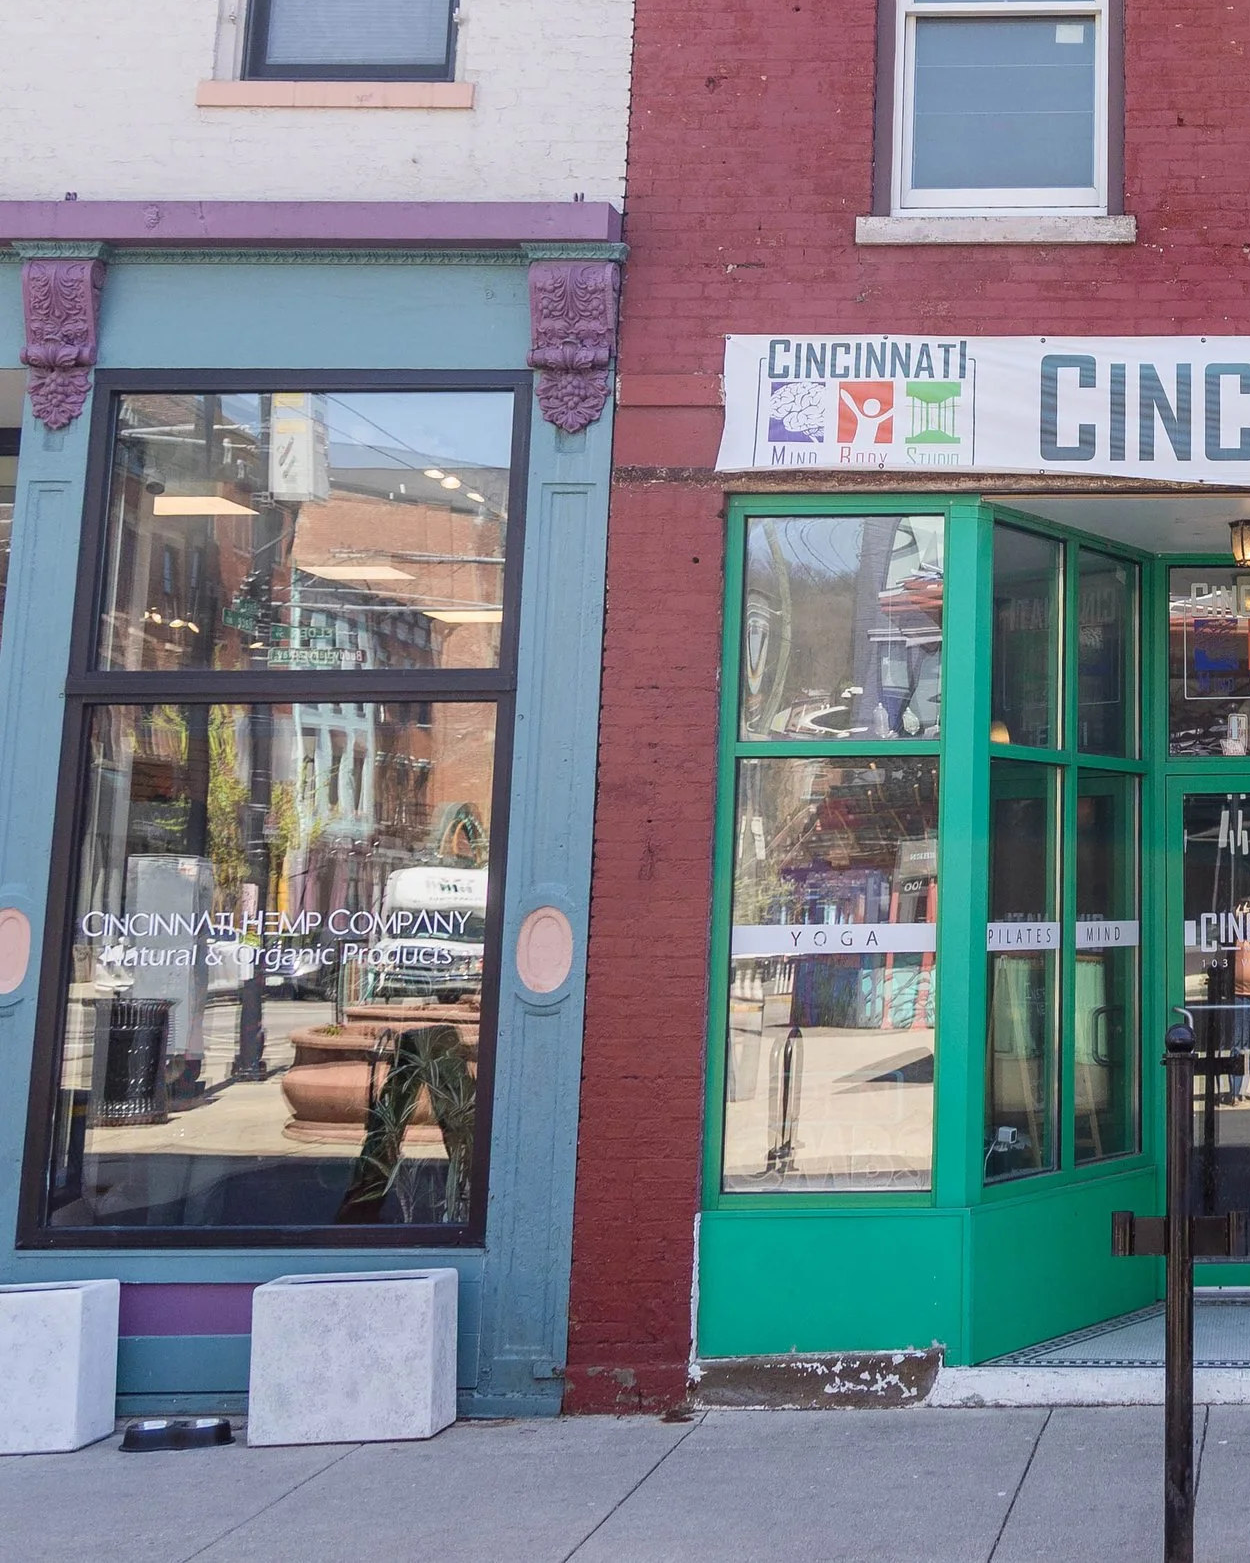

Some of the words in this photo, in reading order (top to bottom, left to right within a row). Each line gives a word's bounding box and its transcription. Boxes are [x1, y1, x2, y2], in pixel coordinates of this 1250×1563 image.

[767, 339, 968, 379] CINCINNATI
[82, 910, 234, 937] CINCINNATI
[243, 910, 322, 936] HEMP
[328, 909, 472, 936] COMPANY
[791, 930, 879, 947] YOGA
[988, 928, 1052, 944] PILATES
[1086, 926, 1121, 942] MIND
[102, 944, 198, 966] Natural
[205, 946, 223, 966] &
[233, 942, 335, 972] Organic
[342, 942, 452, 965] Products
[1201, 958, 1229, 968] 103
